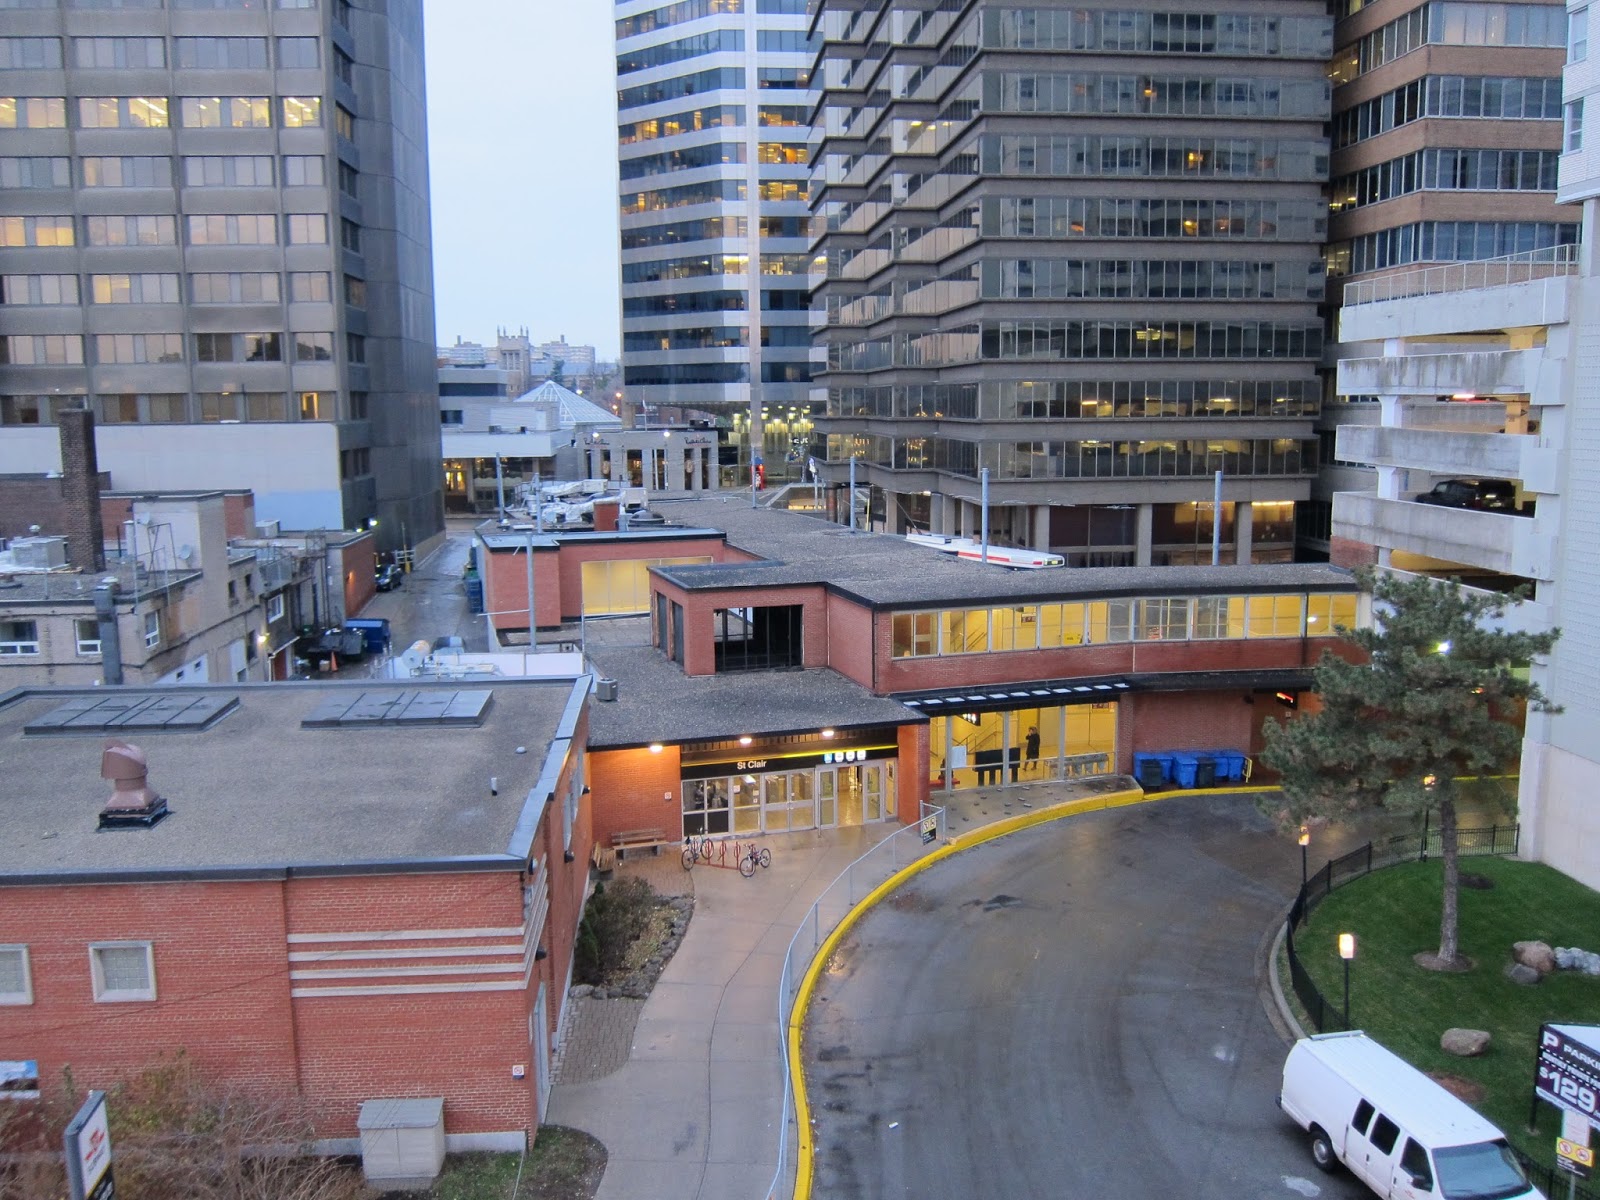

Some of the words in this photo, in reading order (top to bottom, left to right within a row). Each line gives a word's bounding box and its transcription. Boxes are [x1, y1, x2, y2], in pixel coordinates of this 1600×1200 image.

[737, 761, 746, 770] St
[748, 760, 767, 769] Clair
[1543, 1031, 1559, 1047] P
